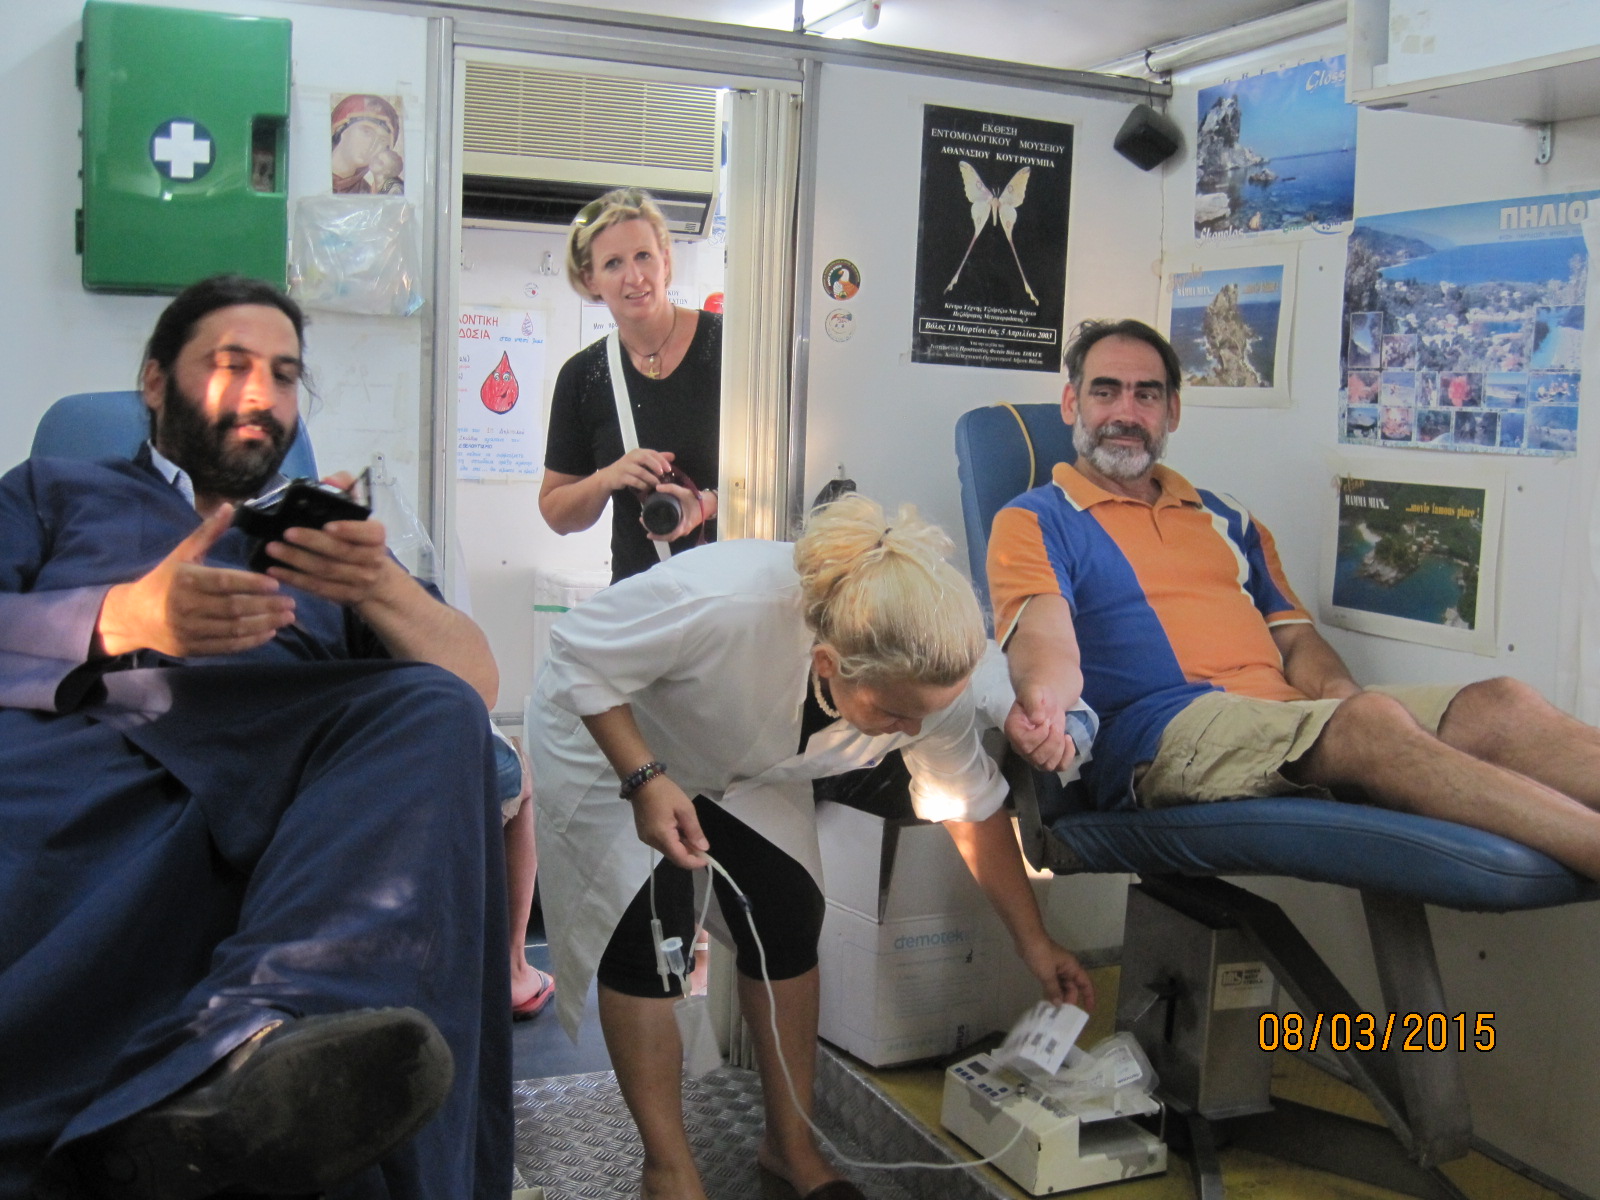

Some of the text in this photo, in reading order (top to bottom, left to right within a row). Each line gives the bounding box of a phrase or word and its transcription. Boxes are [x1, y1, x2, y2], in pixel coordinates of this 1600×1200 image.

[982, 123, 1018, 136] ΕΚΘΕΣΗ
[931, 128, 1065, 154] ΕΝΤΟΜΟΛΟΓΙΚΟΥ ΜΟΥΣΕΙΟΥ
[941, 146, 991, 160] ΑΘΑΝΑΣΙΟΥ
[925, 322, 946, 333] Βόλος
[948, 324, 956, 332] 12
[957, 325, 987, 336] Μαρτίου
[1345, 494, 1367, 508] MAMMA
[1432, 502, 1455, 517] famous
[1457, 507, 1475, 520] place
